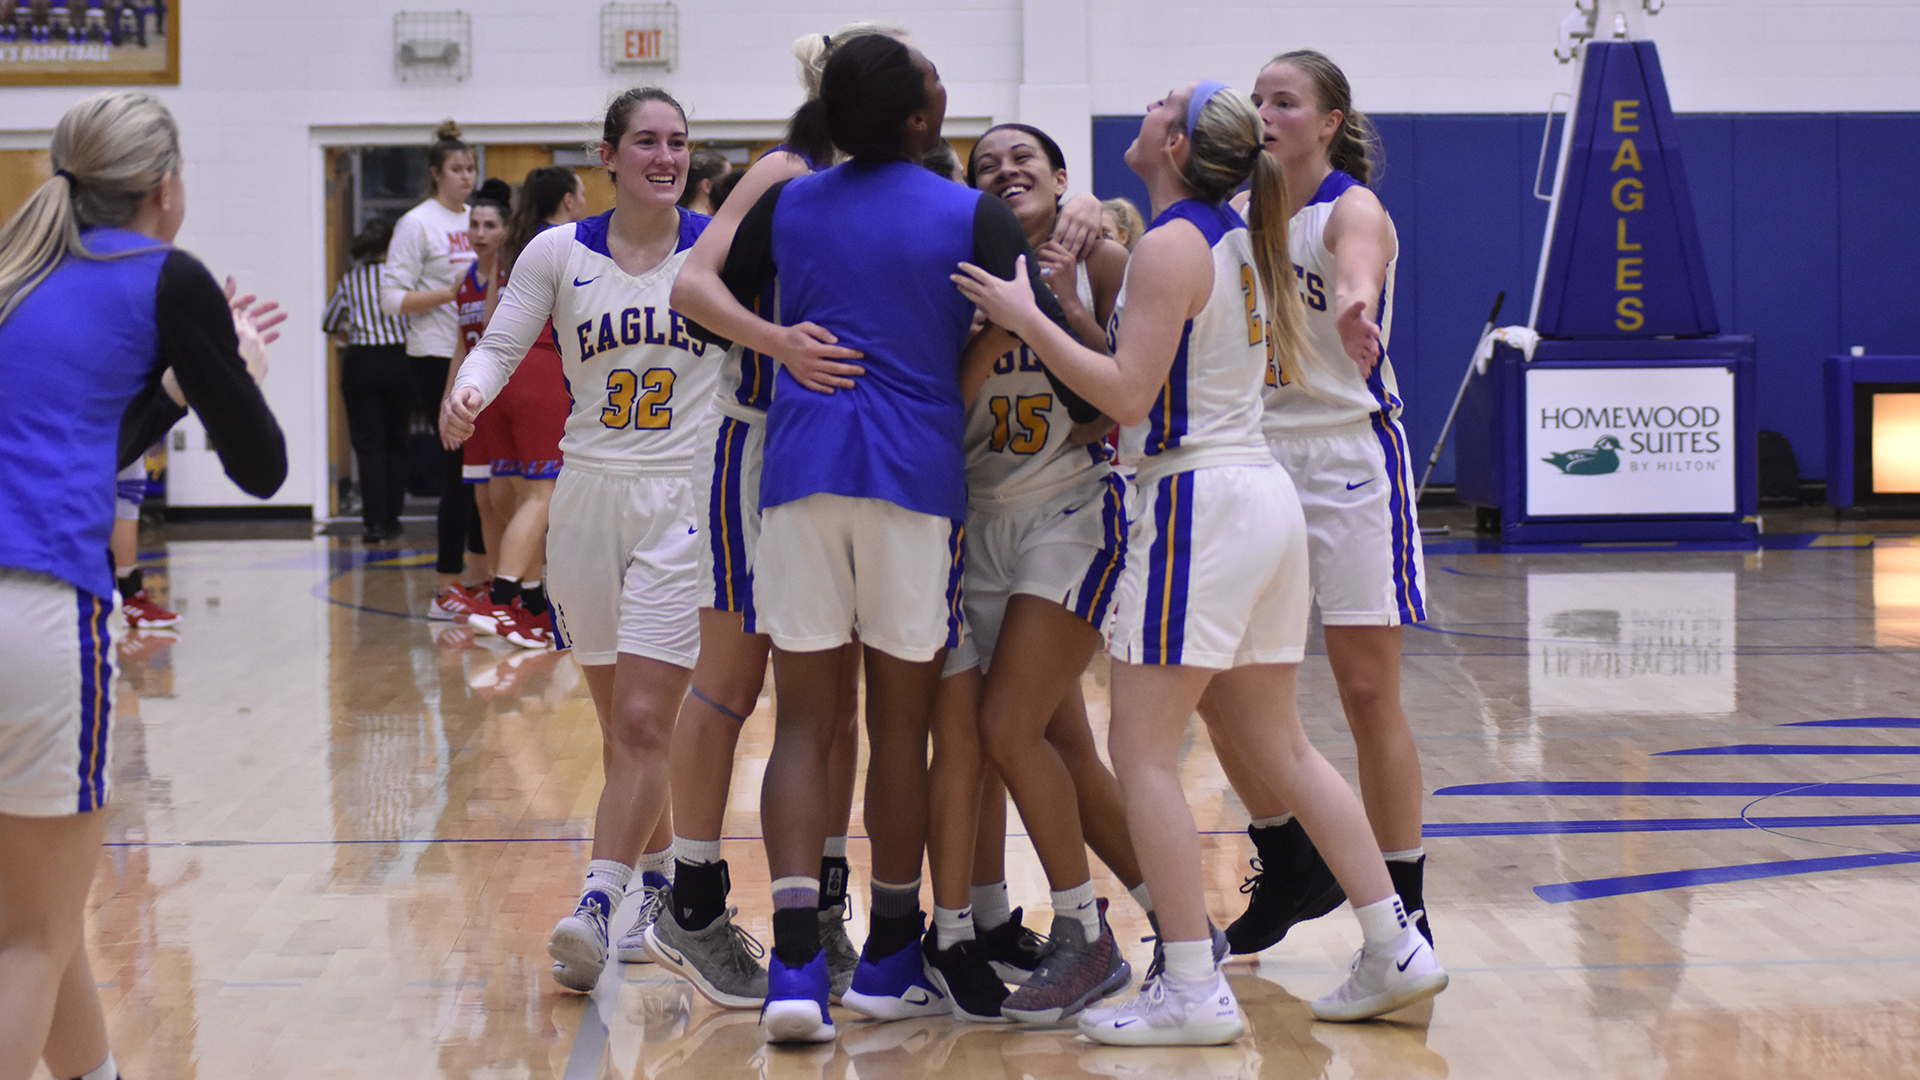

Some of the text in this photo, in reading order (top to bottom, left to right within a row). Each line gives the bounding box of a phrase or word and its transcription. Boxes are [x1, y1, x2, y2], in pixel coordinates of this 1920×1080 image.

[21, 46, 110, 62] BASKETBALL
[625, 29, 662, 58] EXIT
[1610, 100, 1644, 331] EAGLES
[600, 367, 677, 430] 32
[989, 393, 1053, 455] 15
[1541, 406, 1721, 429] HOMEWOOD
[1630, 431, 1721, 454] SUITES
[1630, 460, 1716, 472] BY HILTON
